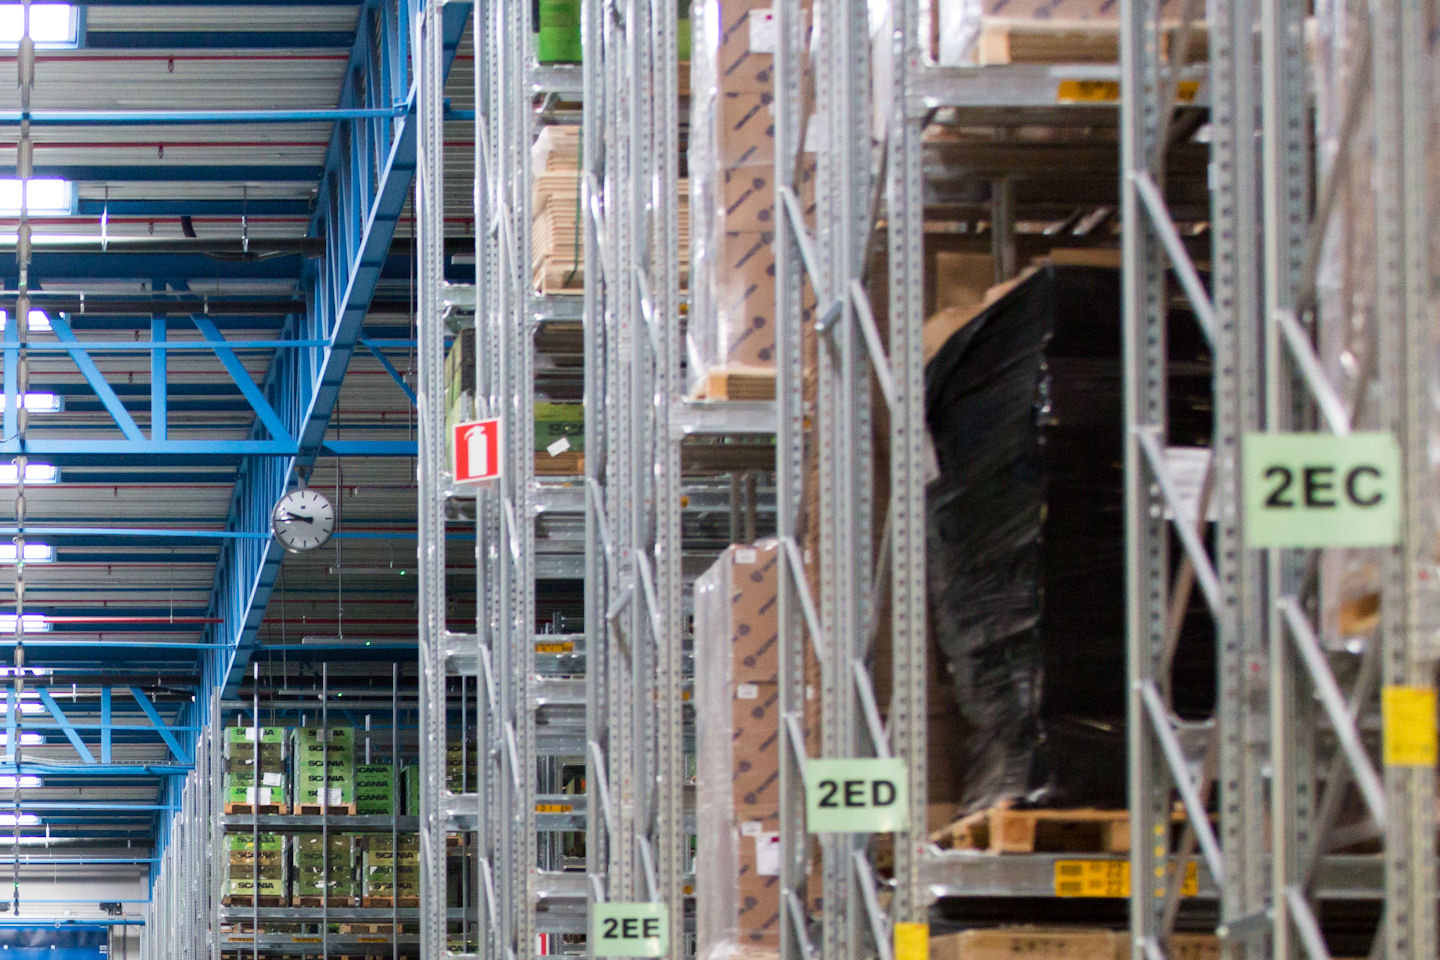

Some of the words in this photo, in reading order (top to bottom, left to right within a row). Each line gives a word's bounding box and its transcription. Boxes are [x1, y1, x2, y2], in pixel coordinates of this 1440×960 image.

[1264, 465, 1383, 509] 2EC
[818, 780, 897, 808] 2ED
[603, 918, 659, 938] 2EE
